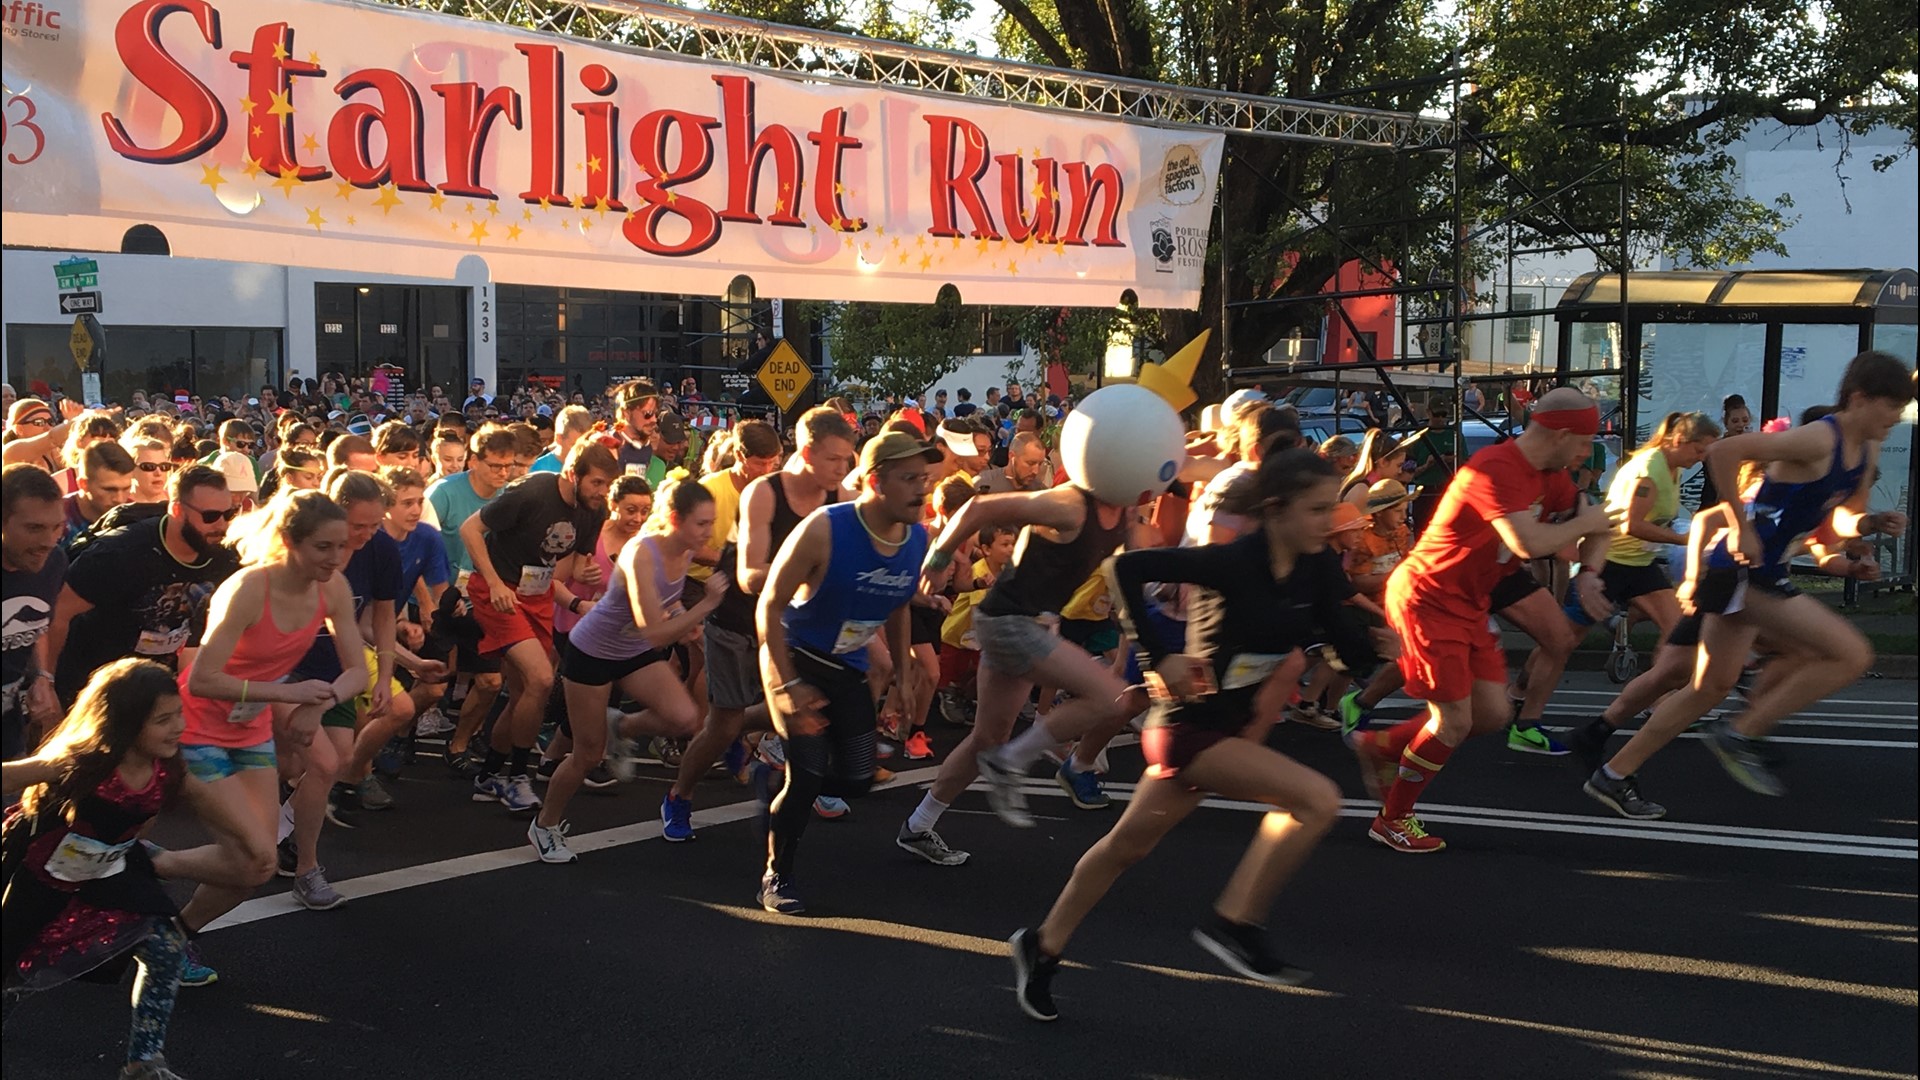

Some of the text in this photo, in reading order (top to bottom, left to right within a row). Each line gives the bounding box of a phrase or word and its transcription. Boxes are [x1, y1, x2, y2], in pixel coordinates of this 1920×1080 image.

[20, 28, 60, 41] Stores!
[2, 95, 45, 165] 3
[101, 0, 1127, 257] Starlight Run
[1166, 154, 1190, 172] the old
[1165, 164, 1201, 184] spaghetti
[1164, 178, 1196, 195] factory
[70, 297, 94, 308] ONE WAY
[769, 361, 801, 375] DEAD
[774, 378, 796, 391] END
